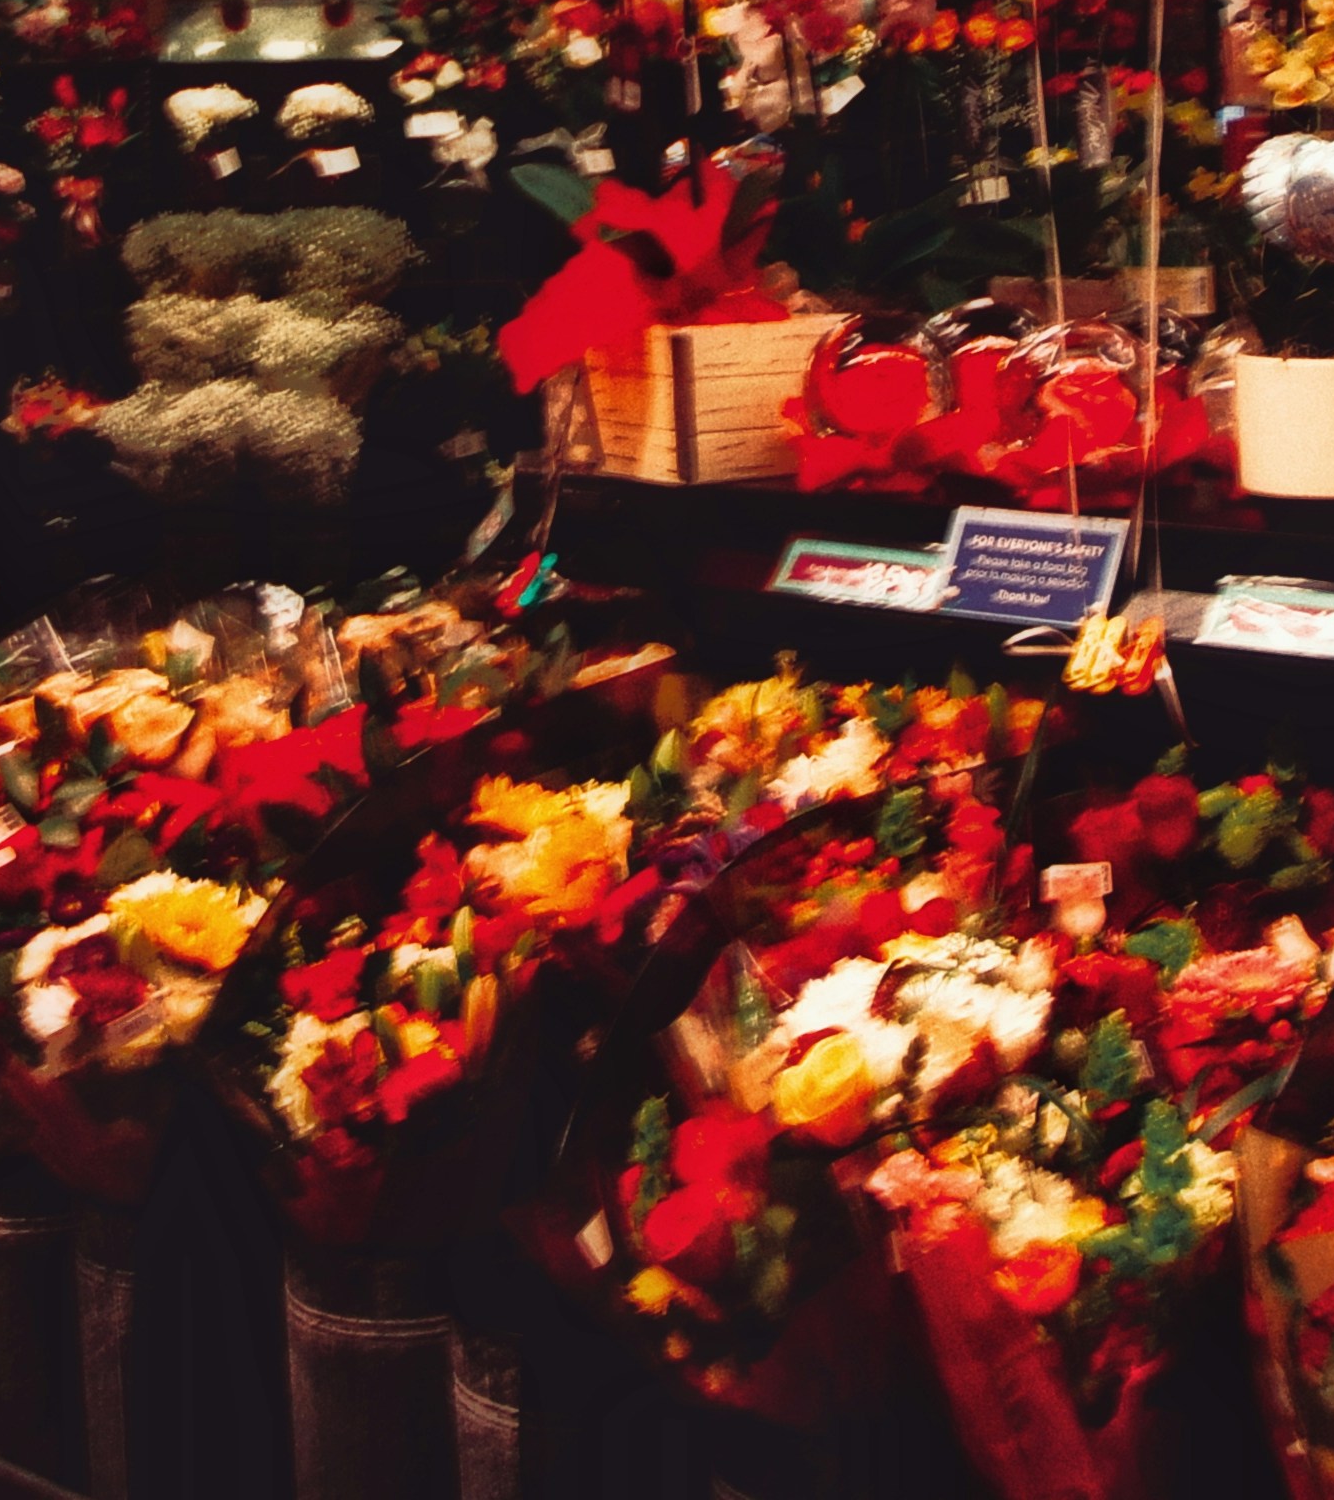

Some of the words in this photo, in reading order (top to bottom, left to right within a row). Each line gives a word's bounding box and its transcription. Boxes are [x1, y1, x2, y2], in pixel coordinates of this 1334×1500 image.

[970, 534, 994, 547] FOR
[997, 536, 1063, 553] EVERYONE'S
[1065, 543, 1105, 557] SAFETY
[976, 554, 1009, 567] Please
[1010, 558, 1031, 569] take
[1041, 560, 1066, 572] floral
[1068, 563, 1088, 576] bag
[965, 568, 988, 581] prior
[989, 569, 999, 579] to
[1001, 572, 1036, 585] making
[998, 589, 1028, 601] Thank
[1029, 592, 1051, 604] You!
